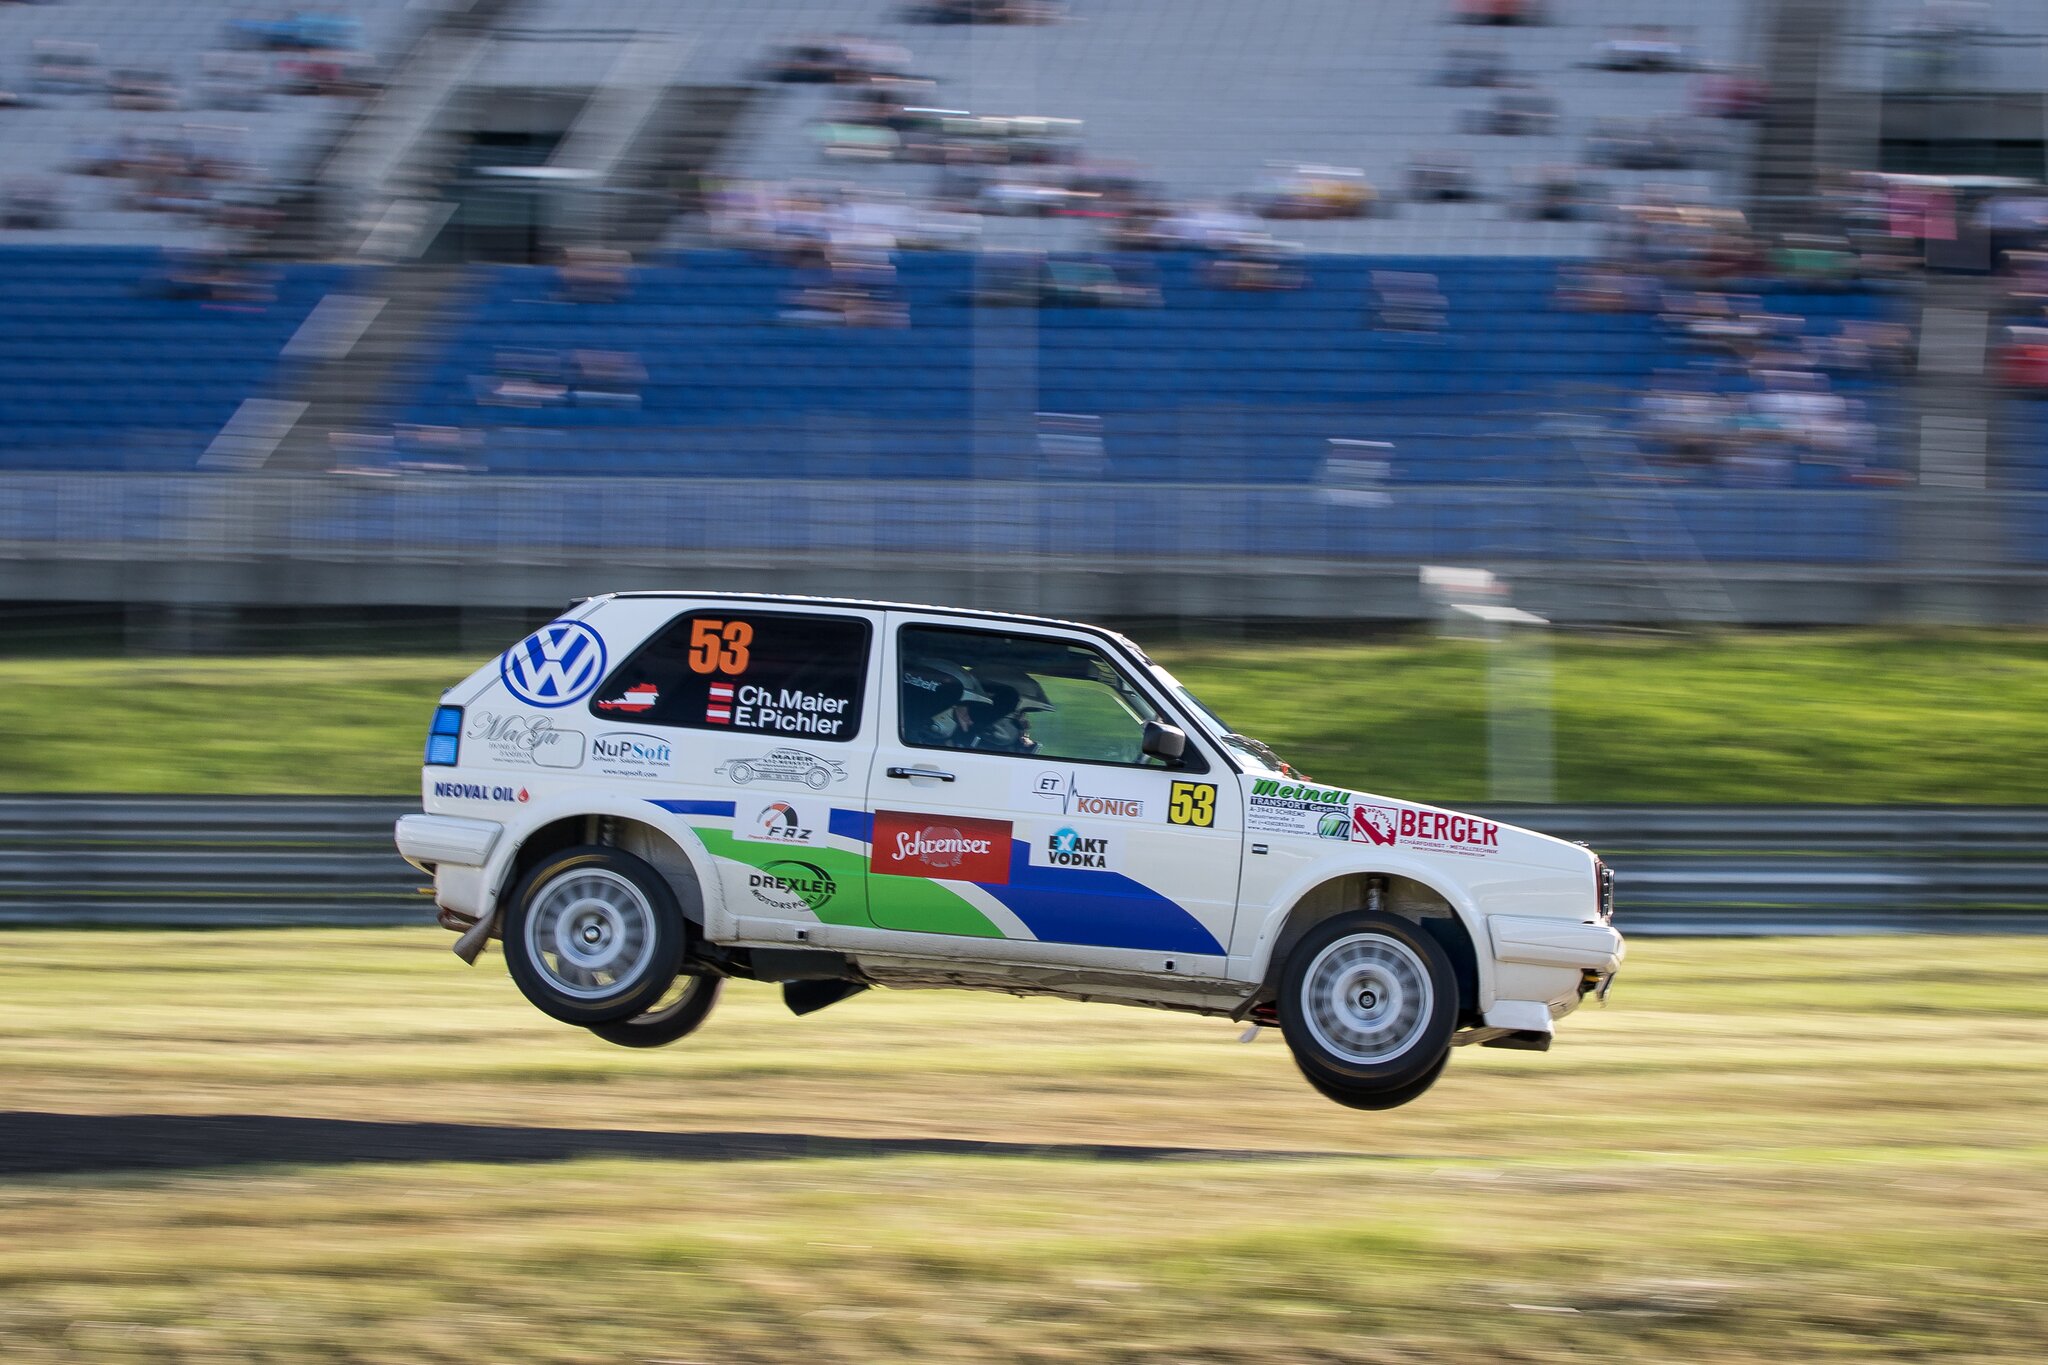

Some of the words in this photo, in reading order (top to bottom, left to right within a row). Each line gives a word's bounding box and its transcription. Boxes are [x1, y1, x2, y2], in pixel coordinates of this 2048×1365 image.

[688, 619, 754, 675] 53
[738, 685, 849, 714] Ch.Maier
[734, 706, 843, 735] E.Pichler
[592, 739, 672, 760] NuPSoft
[435, 782, 489, 800] NEOVAL
[493, 786, 515, 803] OIL
[1041, 778, 1060, 790] ET
[1252, 778, 1352, 805] Meindl
[1171, 783, 1216, 827] 53
[1252, 797, 1307, 810] TRANSPORT
[1400, 809, 1499, 847] BERGER
[891, 830, 991, 860] Schremser
[1048, 832, 1108, 854] EXAKT
[1048, 851, 1107, 868] VODKA
[749, 874, 837, 895] DREXLER
[750, 888, 818, 910] MOTORSPORT
